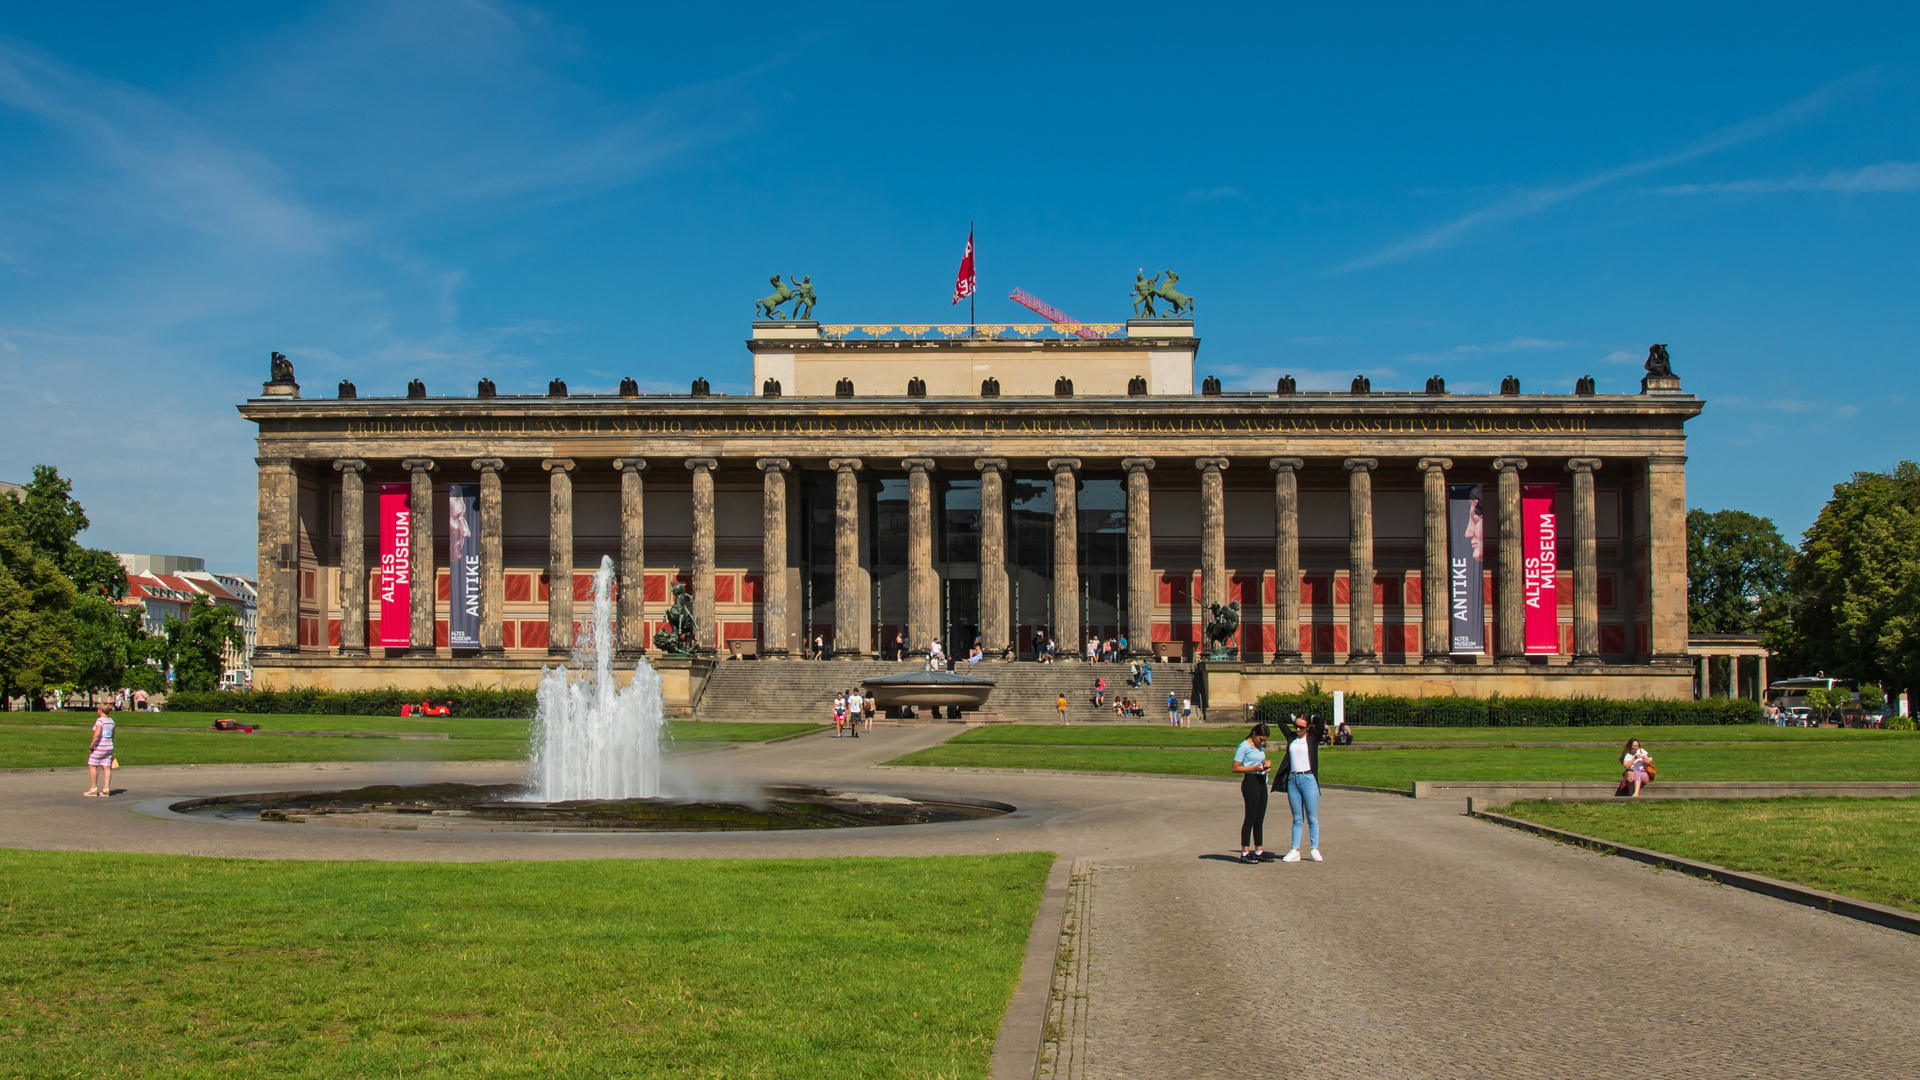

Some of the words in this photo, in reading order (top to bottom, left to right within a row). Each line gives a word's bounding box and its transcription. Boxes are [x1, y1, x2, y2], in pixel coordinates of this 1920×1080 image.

[347, 421, 452, 434] FRIDERICVS
[579, 421, 599, 434] III
[610, 420, 682, 434] STVDIO
[693, 420, 838, 433] ANTIQVITATIS
[847, 420, 974, 433] OMNIGENAE
[984, 420, 1009, 433] ET
[1016, 420, 1096, 433] ARTIVM
[1105, 420, 1226, 433] LIBERALIVM
[1236, 420, 1319, 433] MVSEVM
[1329, 420, 1454, 433] CONSTITVIT
[1462, 420, 1587, 432] MDCCCXXVIII
[381, 553, 395, 603] ALTES
[395, 511, 409, 584] MUSEUM
[1540, 513, 1555, 589] MUSEUM
[466, 555, 479, 617] ANTIKE
[1452, 557, 1468, 622] ANTIKE
[1525, 557, 1540, 609] ALTES
